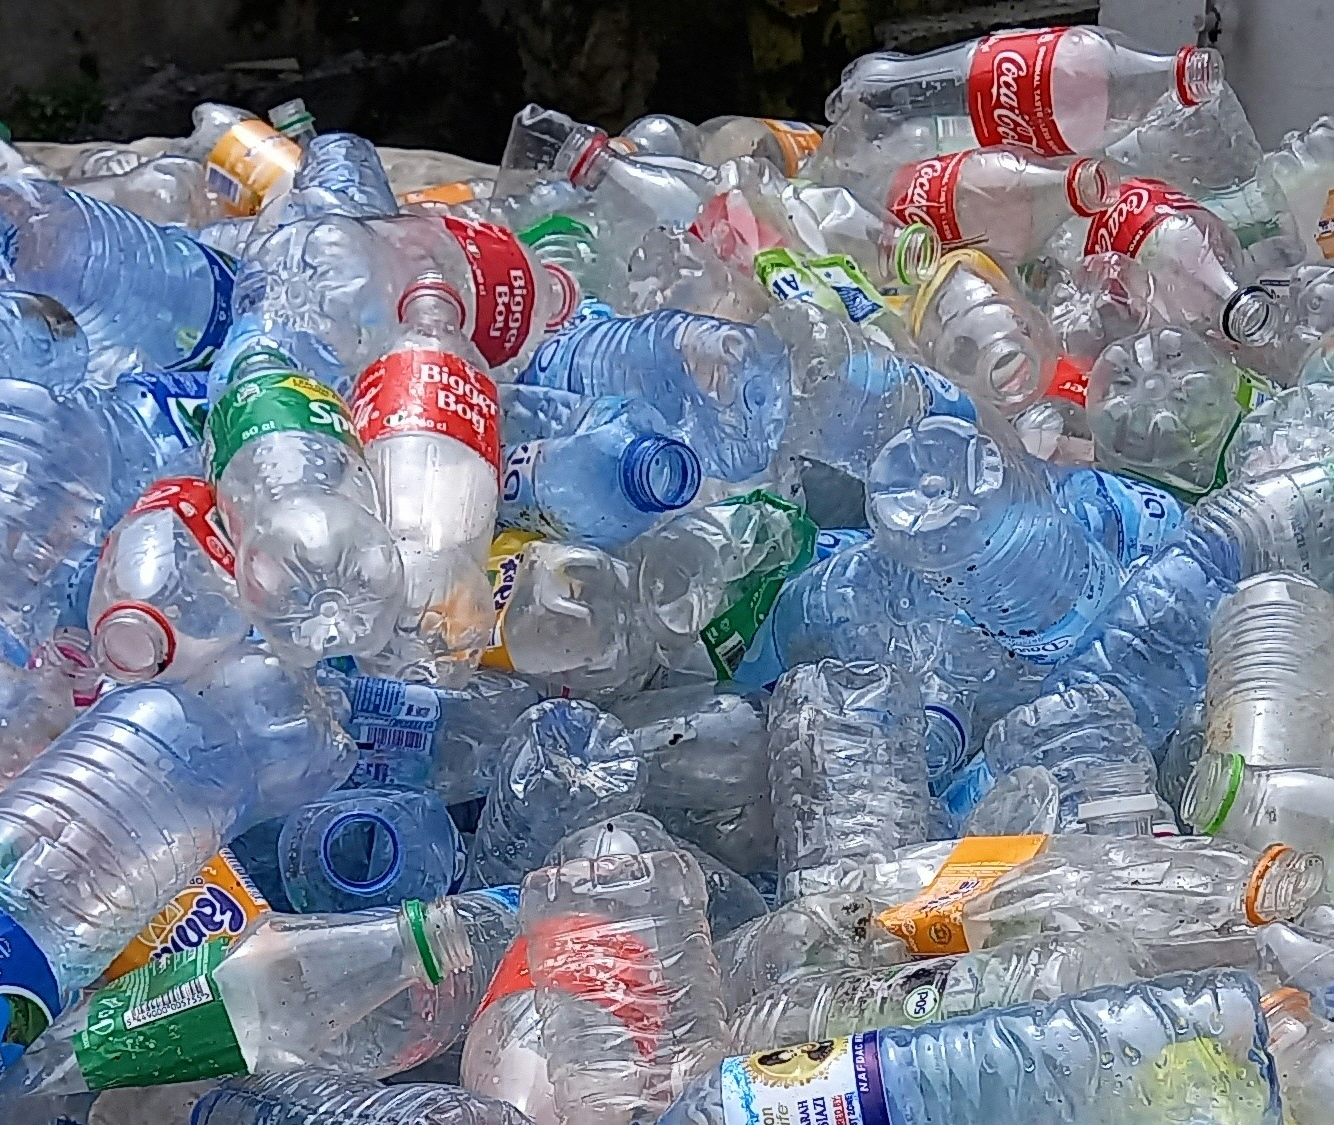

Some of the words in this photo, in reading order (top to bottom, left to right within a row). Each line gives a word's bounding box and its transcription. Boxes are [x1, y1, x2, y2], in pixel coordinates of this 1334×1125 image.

[990, 51, 1045, 155] Coca-Col
[489, 286, 510, 337] Boy
[420, 363, 498, 416] Bigger
[437, 389, 486, 434] Boy
[152, 884, 245, 960] Fan
[853, 1039, 870, 1092] NAFDAC
